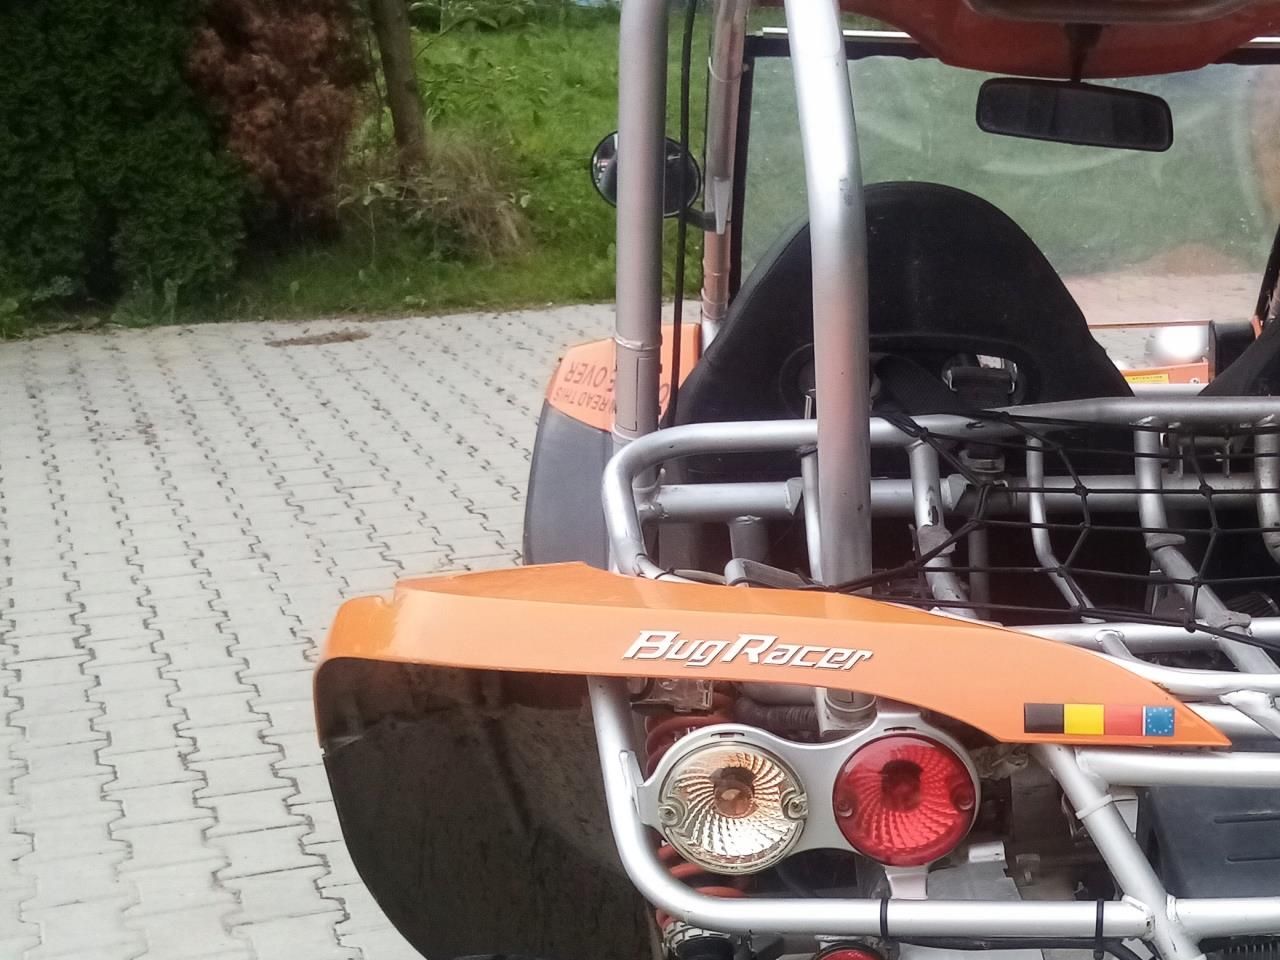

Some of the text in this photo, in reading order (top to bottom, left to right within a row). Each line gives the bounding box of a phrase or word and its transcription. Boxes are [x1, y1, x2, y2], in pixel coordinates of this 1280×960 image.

[563, 362, 608, 388] OVER
[553, 386, 578, 405] THIS
[578, 391, 608, 411] READ
[622, 630, 874, 670] BugRacer
